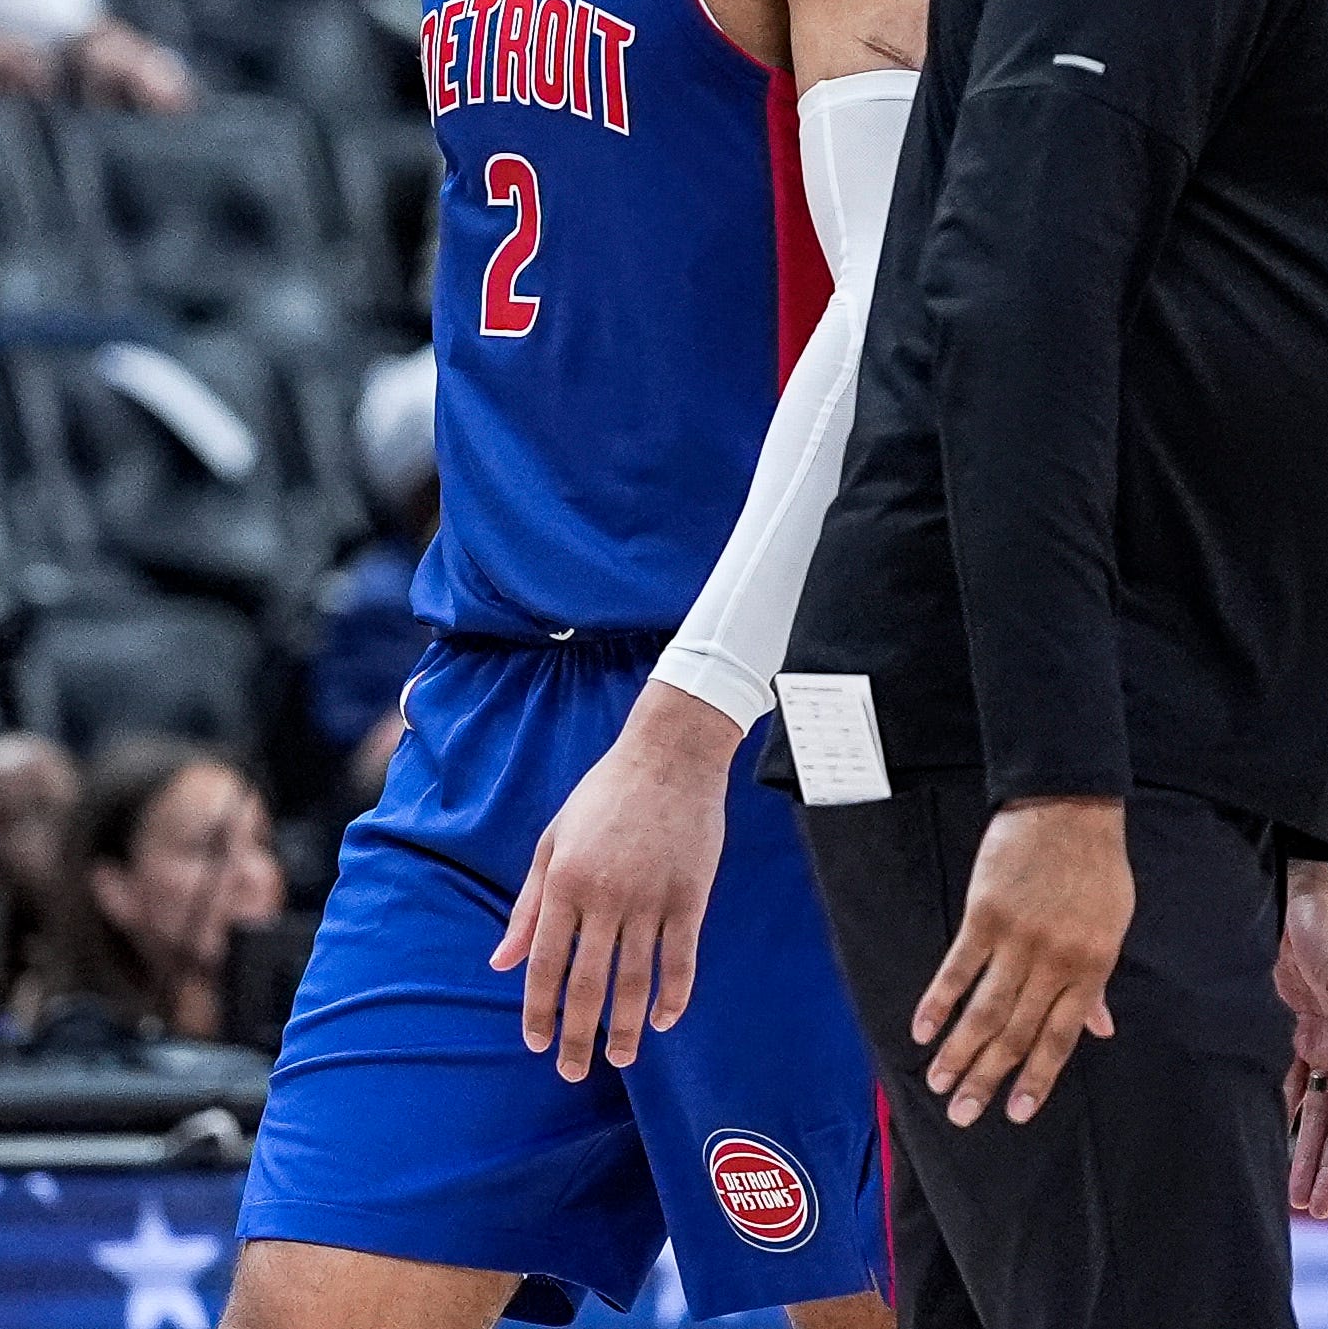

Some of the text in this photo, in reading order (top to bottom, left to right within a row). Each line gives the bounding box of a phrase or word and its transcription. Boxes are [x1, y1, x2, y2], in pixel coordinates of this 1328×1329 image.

[479, 151, 543, 338] 2
[719, 1168, 784, 1192] DETROIT
[726, 1188, 795, 1212] PISTONS
